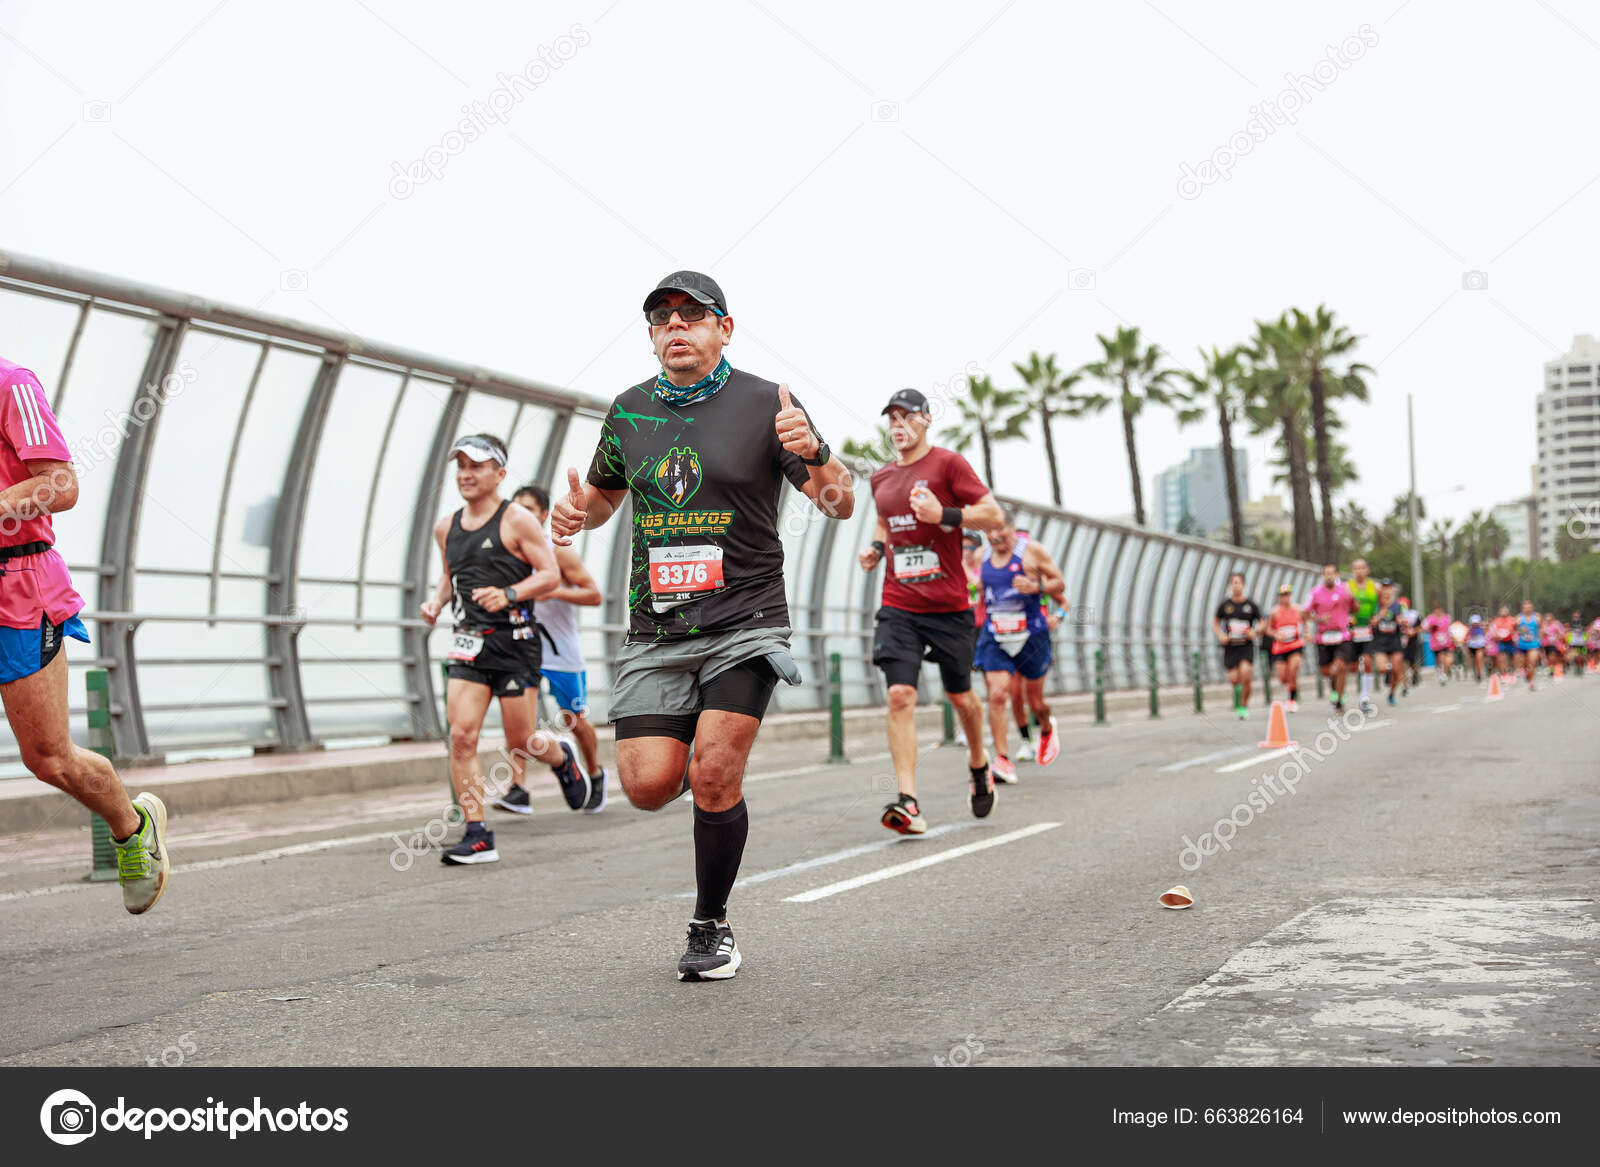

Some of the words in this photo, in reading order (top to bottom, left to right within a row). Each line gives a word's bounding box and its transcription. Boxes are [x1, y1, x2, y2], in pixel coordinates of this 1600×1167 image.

[641, 514, 664, 528] LOS
[667, 512, 732, 526] OLIVOS
[657, 563, 708, 585] 3376
[676, 592, 691, 600] 21K
